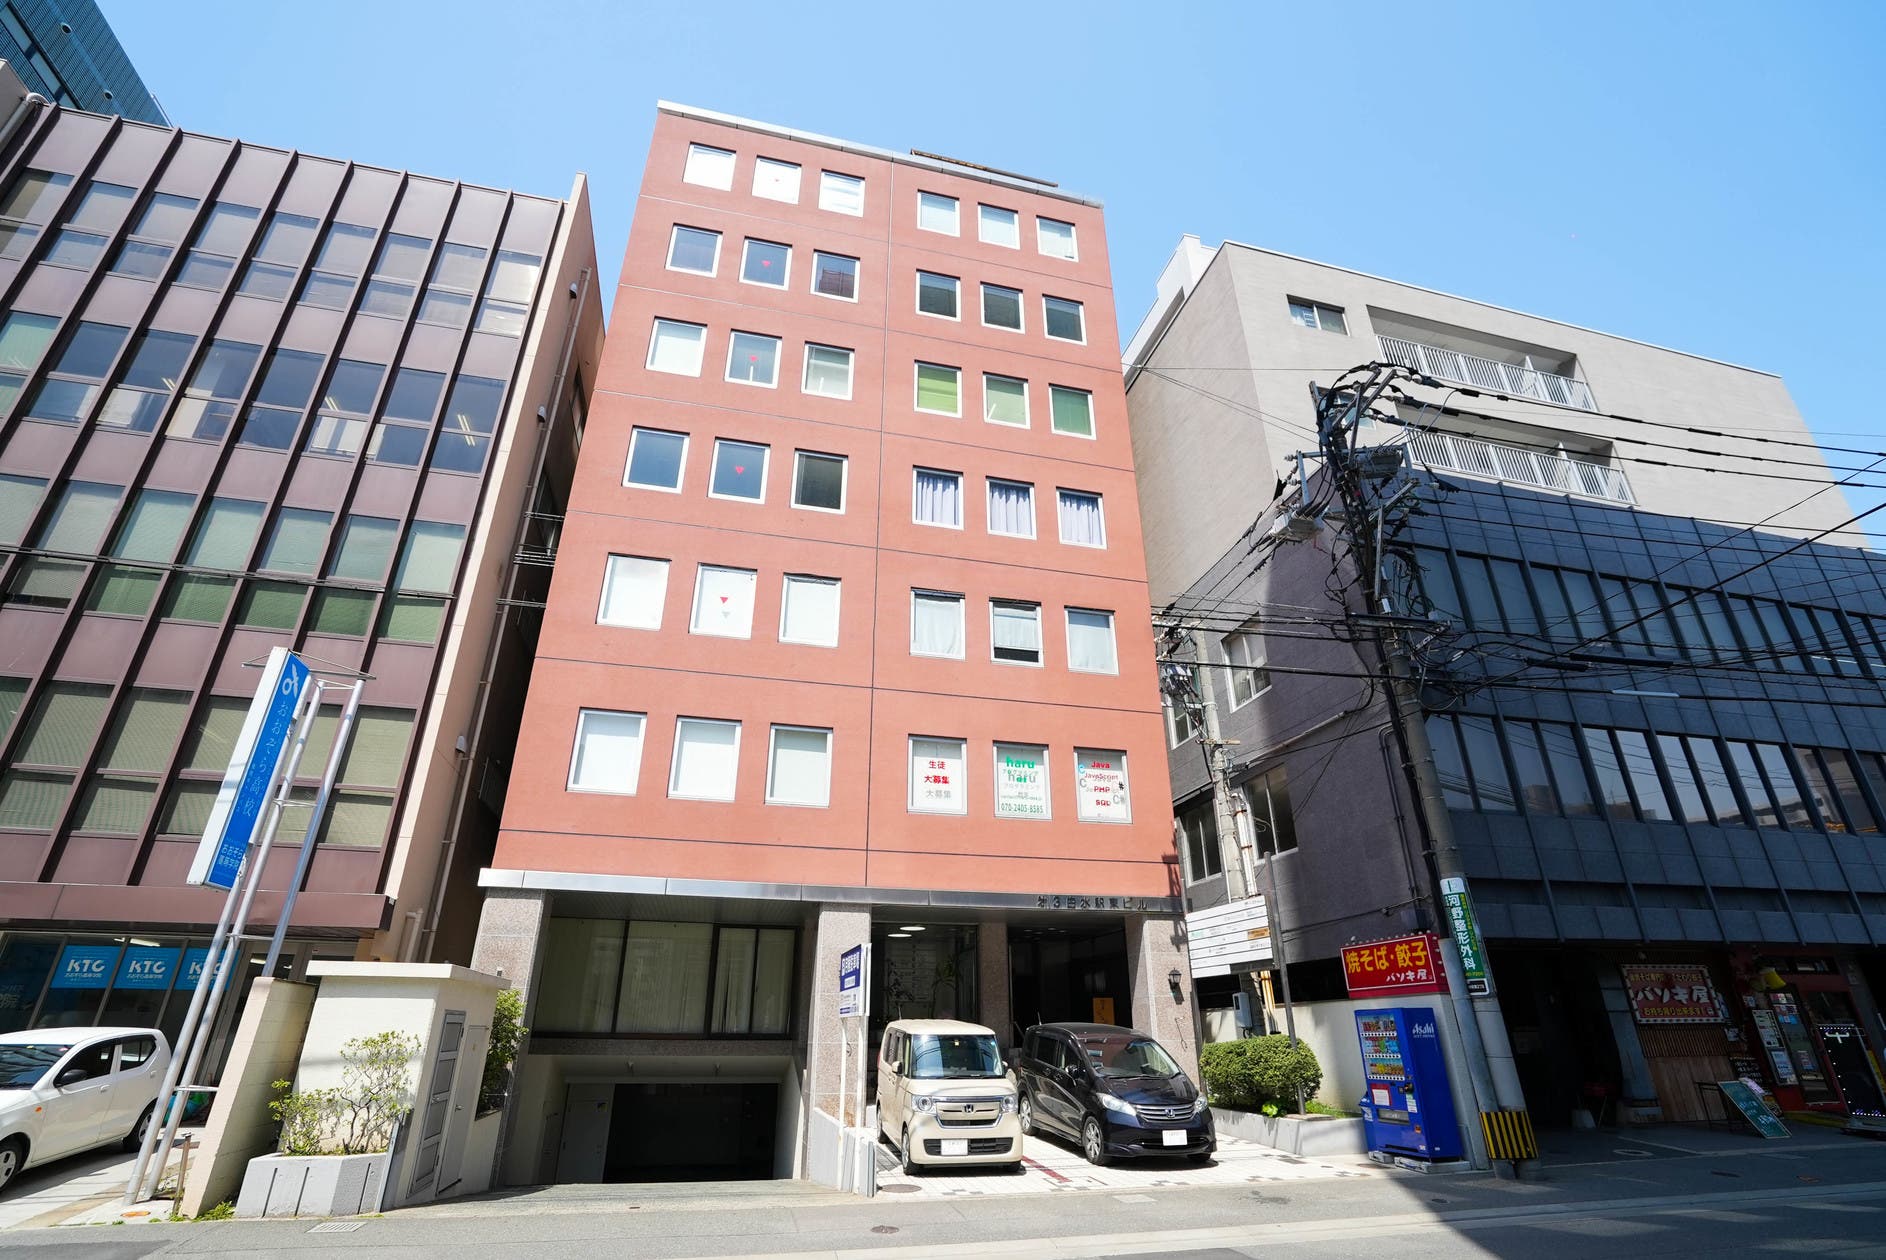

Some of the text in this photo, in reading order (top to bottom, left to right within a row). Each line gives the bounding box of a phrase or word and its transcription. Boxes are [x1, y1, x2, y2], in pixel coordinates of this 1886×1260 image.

[928, 760, 946, 770] 生徒
[1006, 756, 1035, 769] haru
[1091, 761, 1111, 769] Java
[924, 775, 950, 785] 大募集
[1444, 894, 1476, 970] 河野整形外科
[1345, 941, 1428, 974] 焼そば・餃子
[66, 959, 105, 973] KTC
[128, 960, 167, 974] KTC
[1412, 1022, 1435, 1035] Asahi
